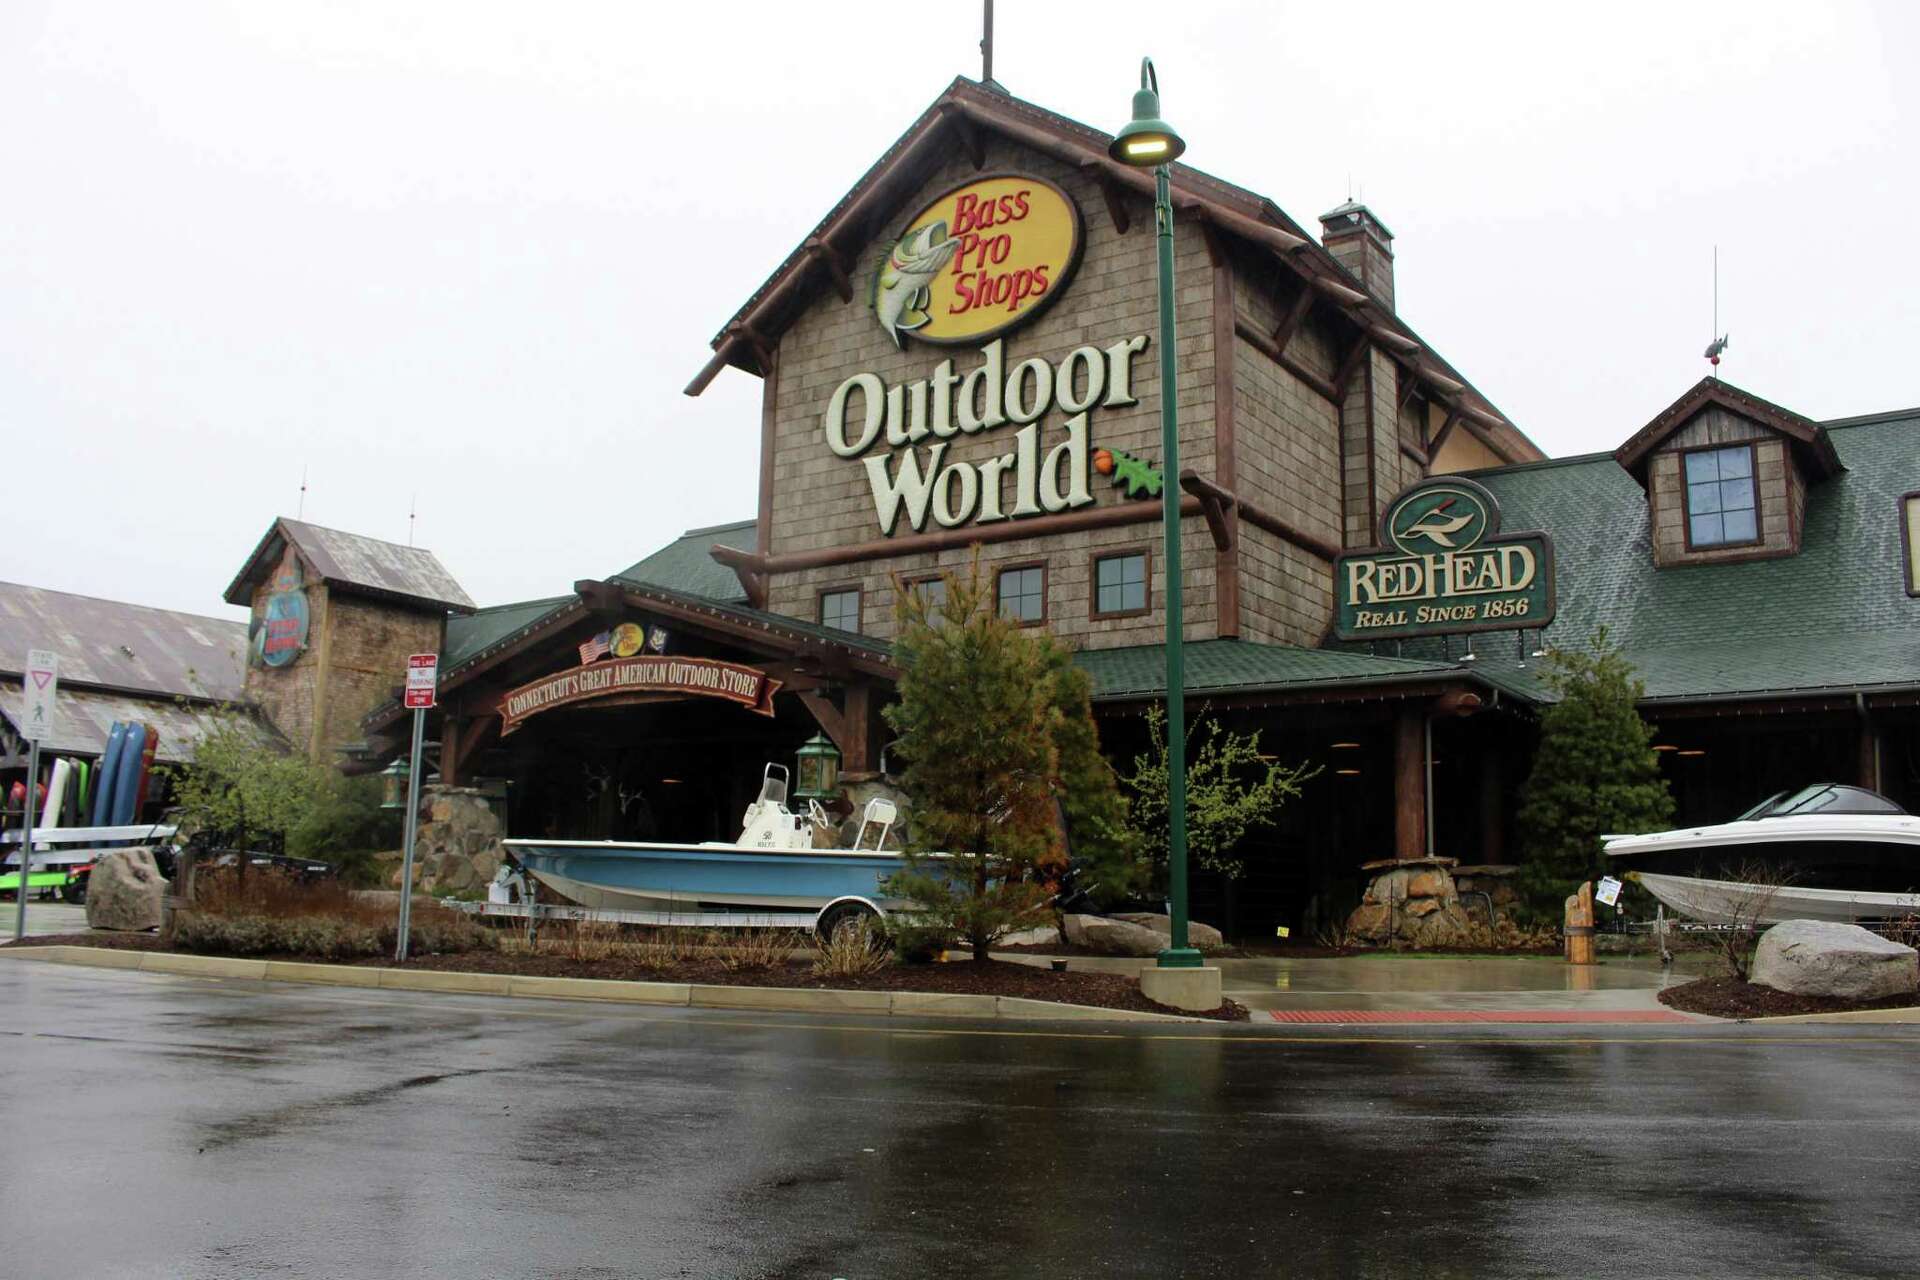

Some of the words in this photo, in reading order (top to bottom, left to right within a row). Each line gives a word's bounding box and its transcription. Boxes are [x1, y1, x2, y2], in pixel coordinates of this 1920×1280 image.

[950, 190, 1031, 237] Bass
[950, 231, 1012, 275] Pro
[949, 264, 1050, 315] Shops
[826, 334, 1151, 458] Outdoor
[862, 411, 1095, 537] World
[1354, 610, 1408, 628] REAL
[1416, 604, 1476, 623] SINCE
[1481, 598, 1529, 619] 1856
[507, 674, 580, 717] CONNECTICUT'S
[580, 667, 613, 692] GREAT
[614, 663, 668, 686] AMERICAN
[668, 662, 720, 688] OUTDOOR
[719, 668, 758, 697] STORE
